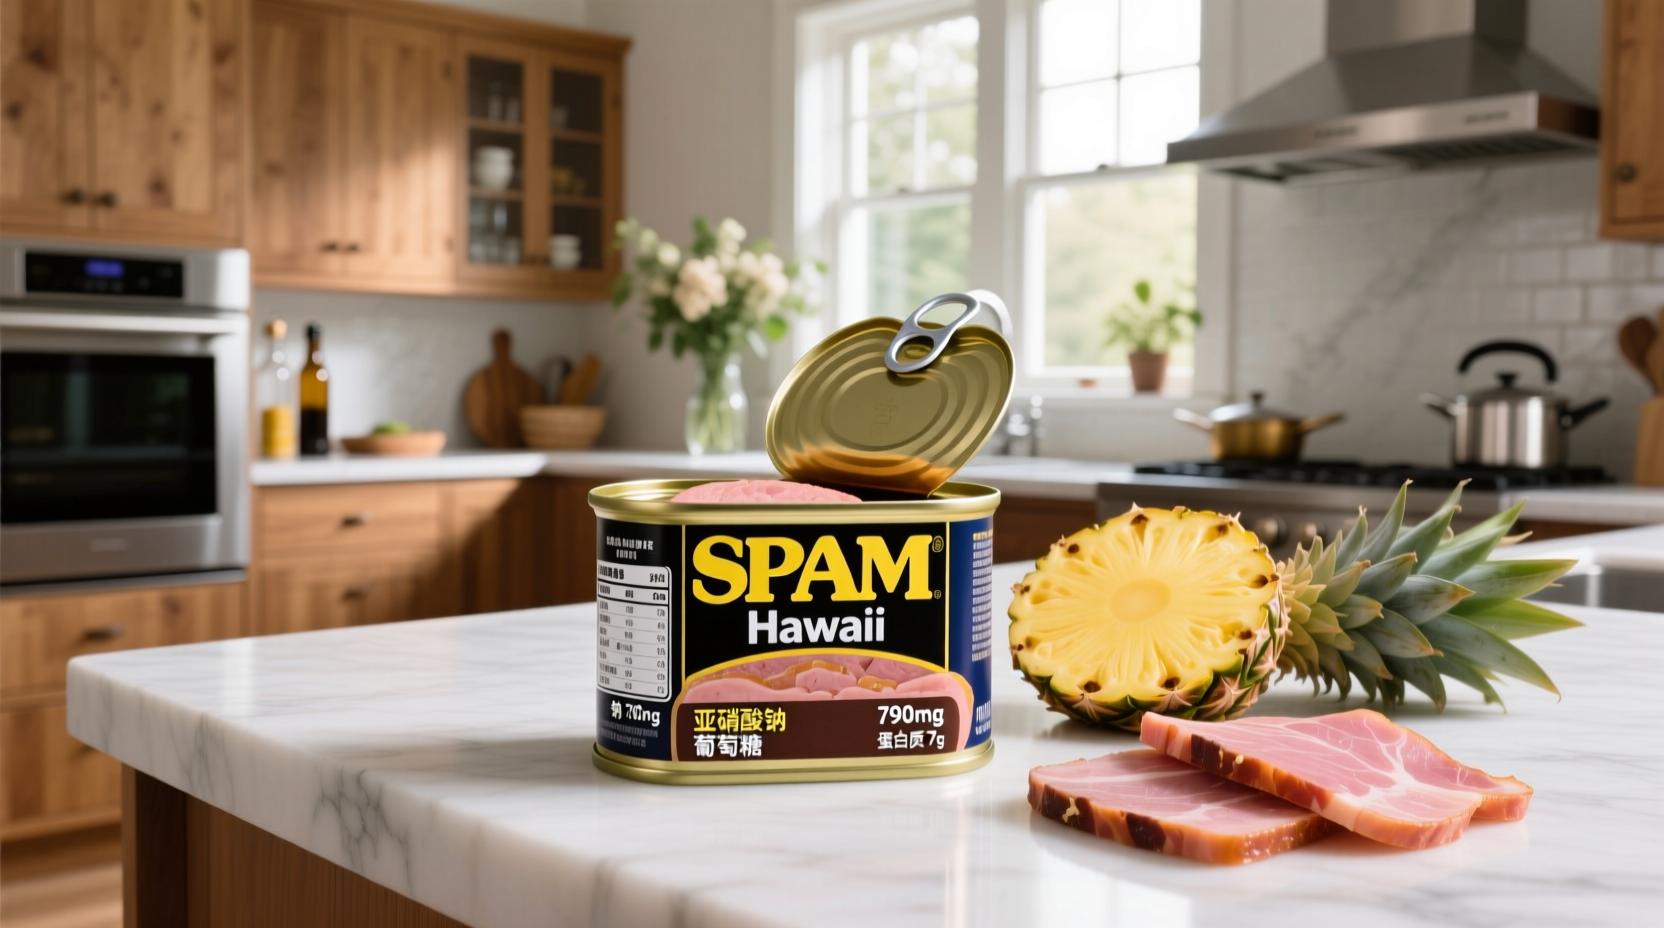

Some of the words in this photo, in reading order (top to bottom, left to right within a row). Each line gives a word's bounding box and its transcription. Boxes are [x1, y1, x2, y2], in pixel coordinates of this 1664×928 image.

[692, 535, 933, 605] SPAM
[748, 606, 885, 645] Hawaii
[693, 707, 786, 733] 亚硝酸钠
[877, 704, 945, 728] 790mg
[693, 733, 763, 758] 葡萄糖
